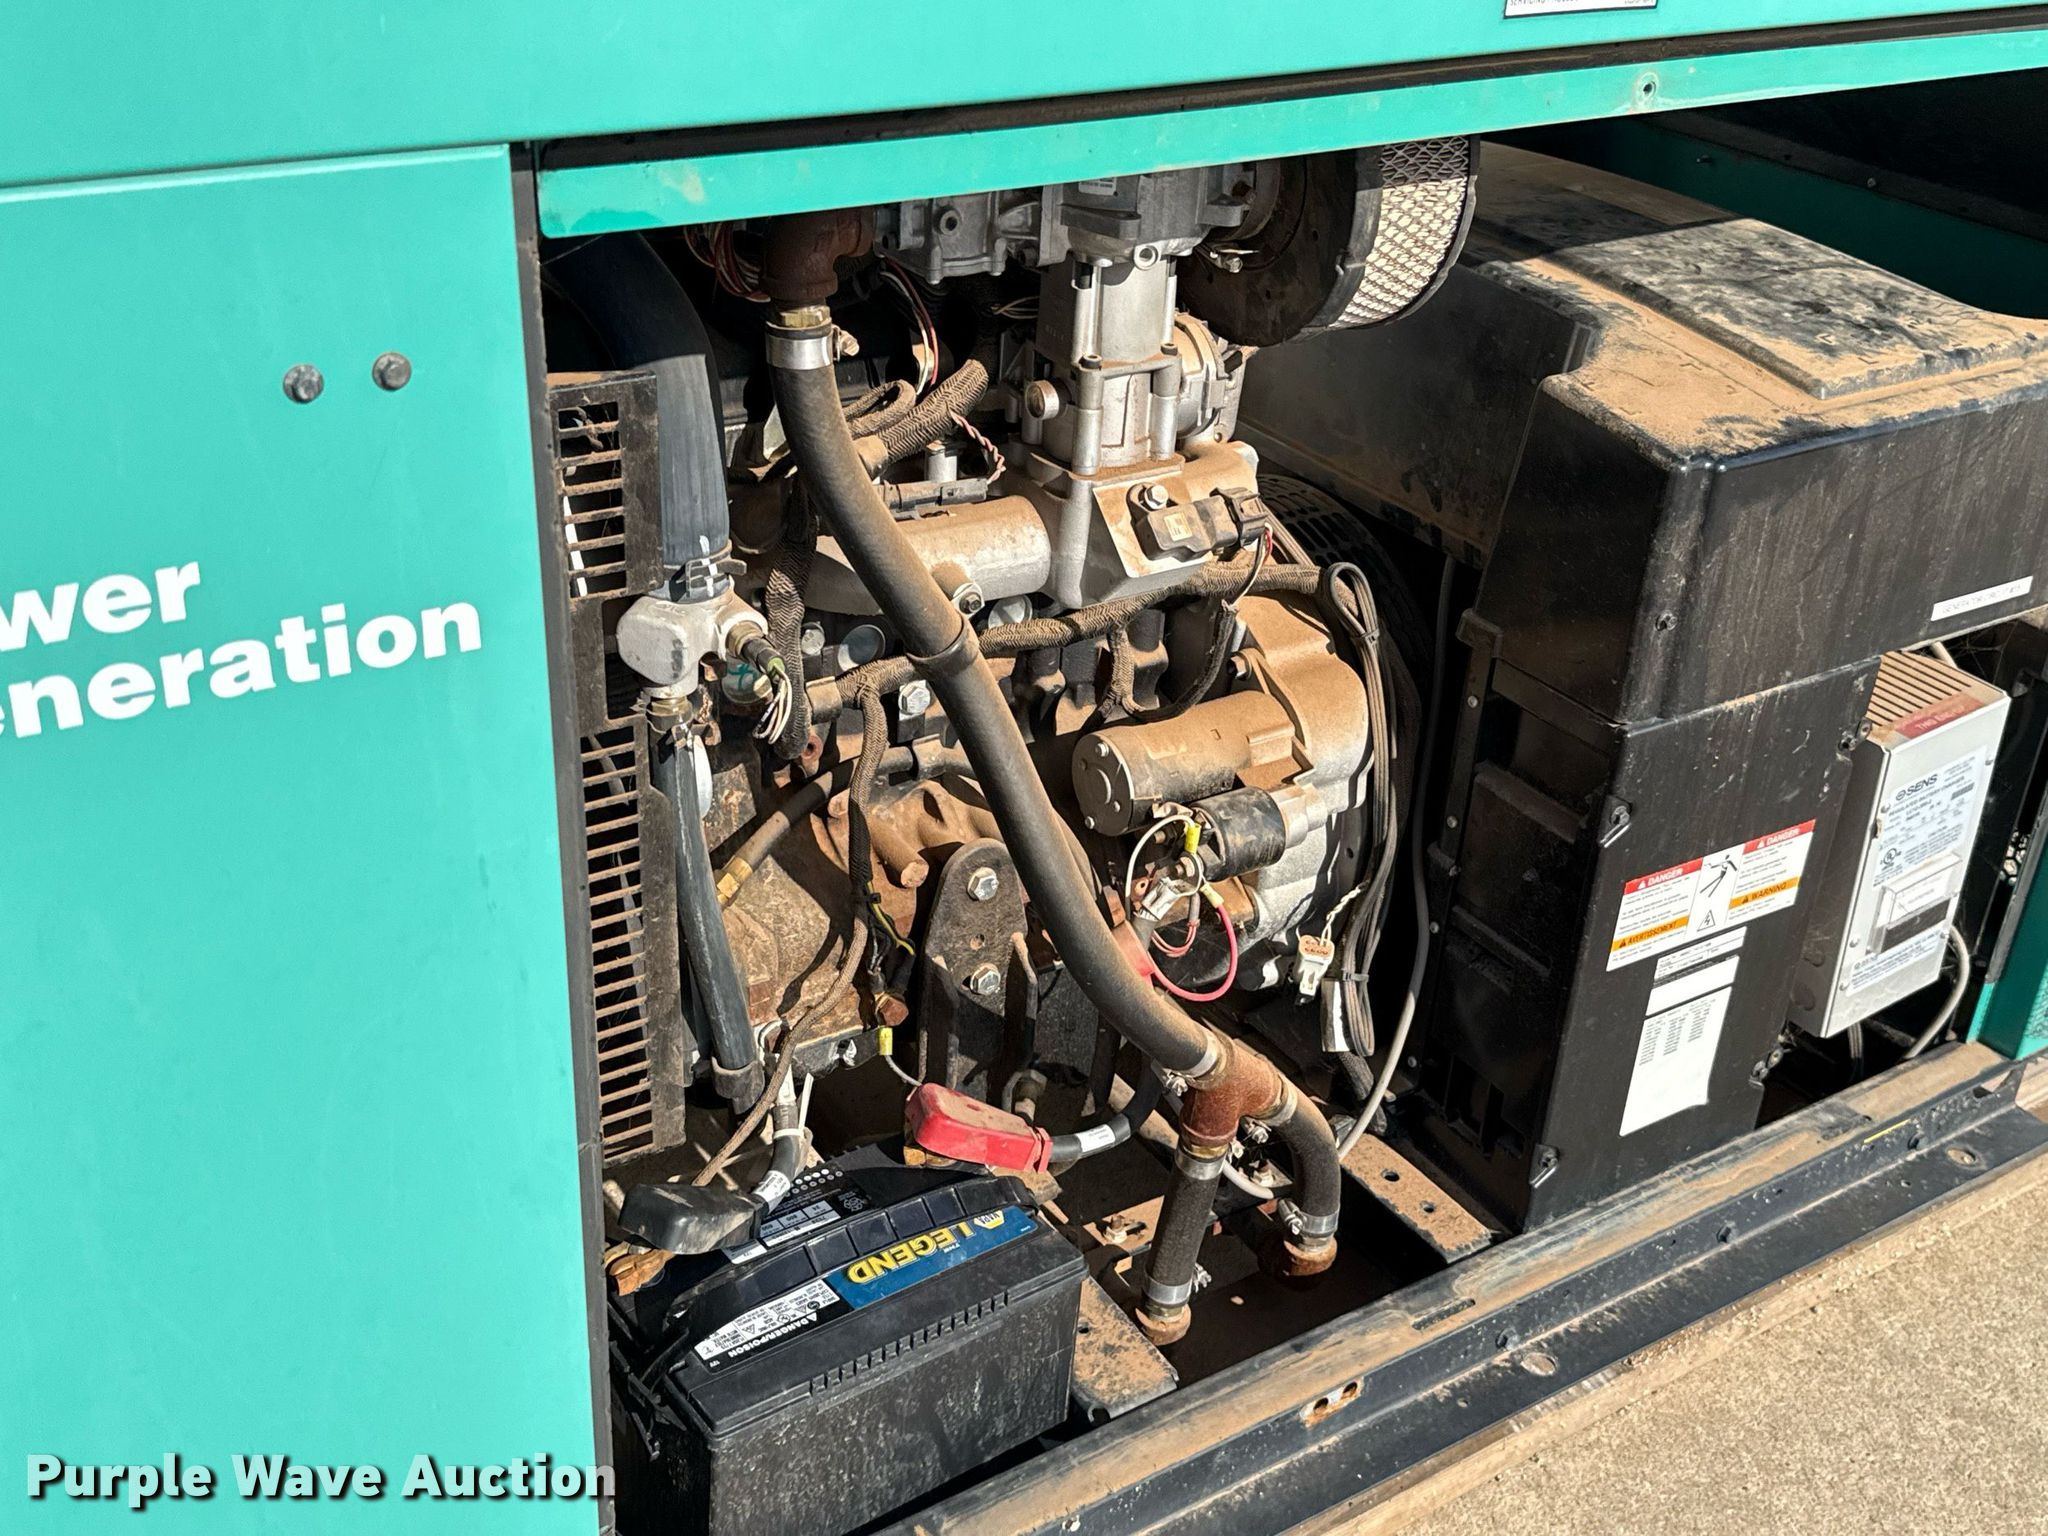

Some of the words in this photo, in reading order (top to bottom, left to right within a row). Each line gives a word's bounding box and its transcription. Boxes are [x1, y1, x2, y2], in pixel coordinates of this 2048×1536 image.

[0, 599, 482, 738] neration
[1907, 773, 1938, 796] SENS
[1767, 828, 1799, 845] DANGER
[1648, 868, 1683, 886] DANGER
[1751, 883, 1786, 900] WARNING
[847, 1221, 976, 1284] LEGEND
[944, 1242, 960, 1254] THE
[728, 1318, 809, 1358] DANGER/POISON
